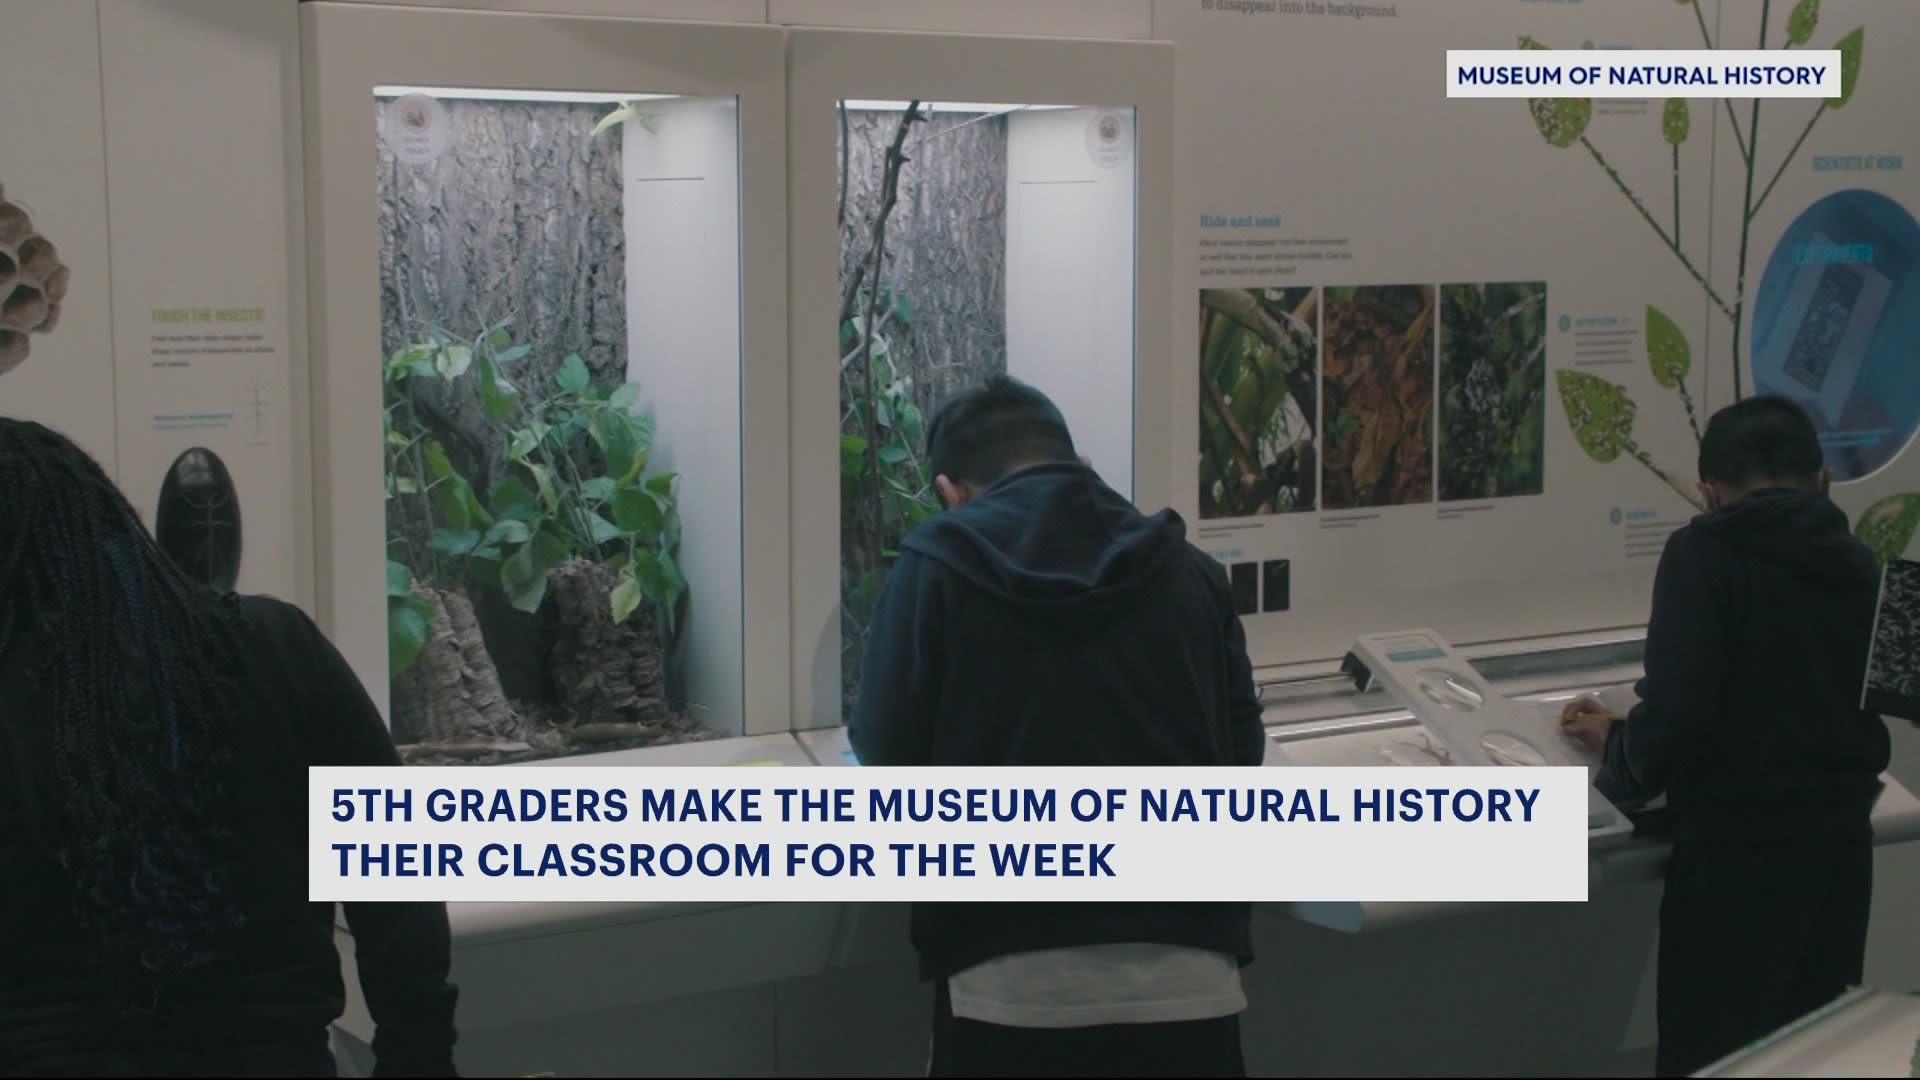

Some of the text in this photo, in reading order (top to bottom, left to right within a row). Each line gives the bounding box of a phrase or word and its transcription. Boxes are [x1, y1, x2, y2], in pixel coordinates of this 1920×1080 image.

[1279, 0, 1303, 14] into
[1305, 1, 1325, 15] the
[1229, 215, 1253, 228] and
